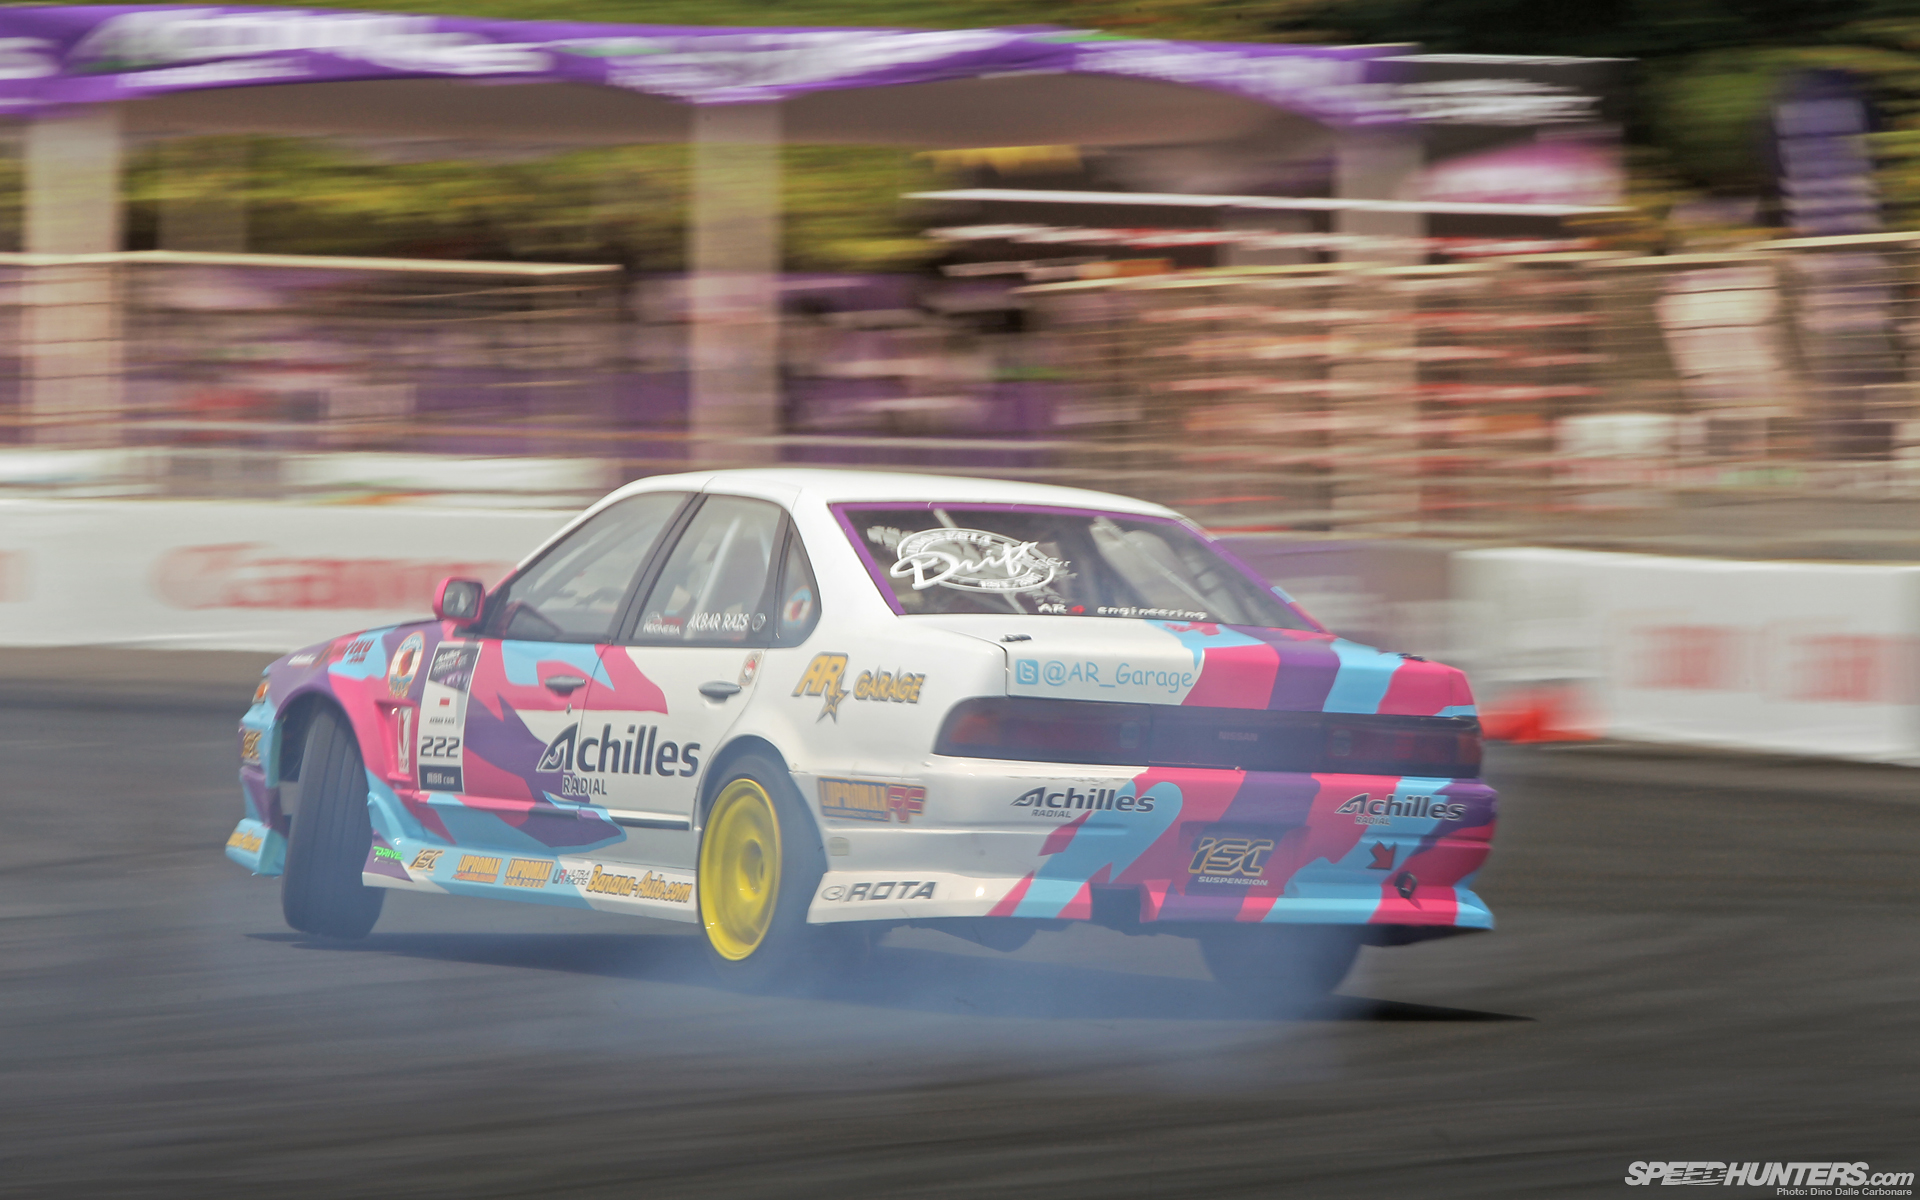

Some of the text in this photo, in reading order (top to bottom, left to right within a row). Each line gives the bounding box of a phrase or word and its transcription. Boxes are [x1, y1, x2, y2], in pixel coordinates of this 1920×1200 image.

[890, 541, 1039, 590] Drift
[686, 612, 720, 632] AKBAR
[1097, 606, 1208, 621] engineering
[791, 651, 926, 704] AR GARAGE
[1043, 660, 1194, 693] @AR_Garage
[420, 736, 460, 758] 222
[535, 722, 701, 778] Achilles
[562, 774, 607, 796] RADIAL
[1011, 786, 1156, 813] Achilles
[1335, 793, 1468, 822] Achilles
[1031, 809, 1071, 819] RADIAL
[1355, 816, 1391, 826] RADIAL
[373, 846, 404, 860] DRIVE
[1188, 837, 1275, 877] ISC
[456, 854, 503, 875] LUPROMAX
[505, 858, 554, 881] LUPROMAX
[568, 869, 590, 878] ULTRA
[586, 864, 693, 903] Banana-Auto.com
[843, 881, 937, 902] ROTA
[1198, 876, 1269, 886] SUSPENSION
